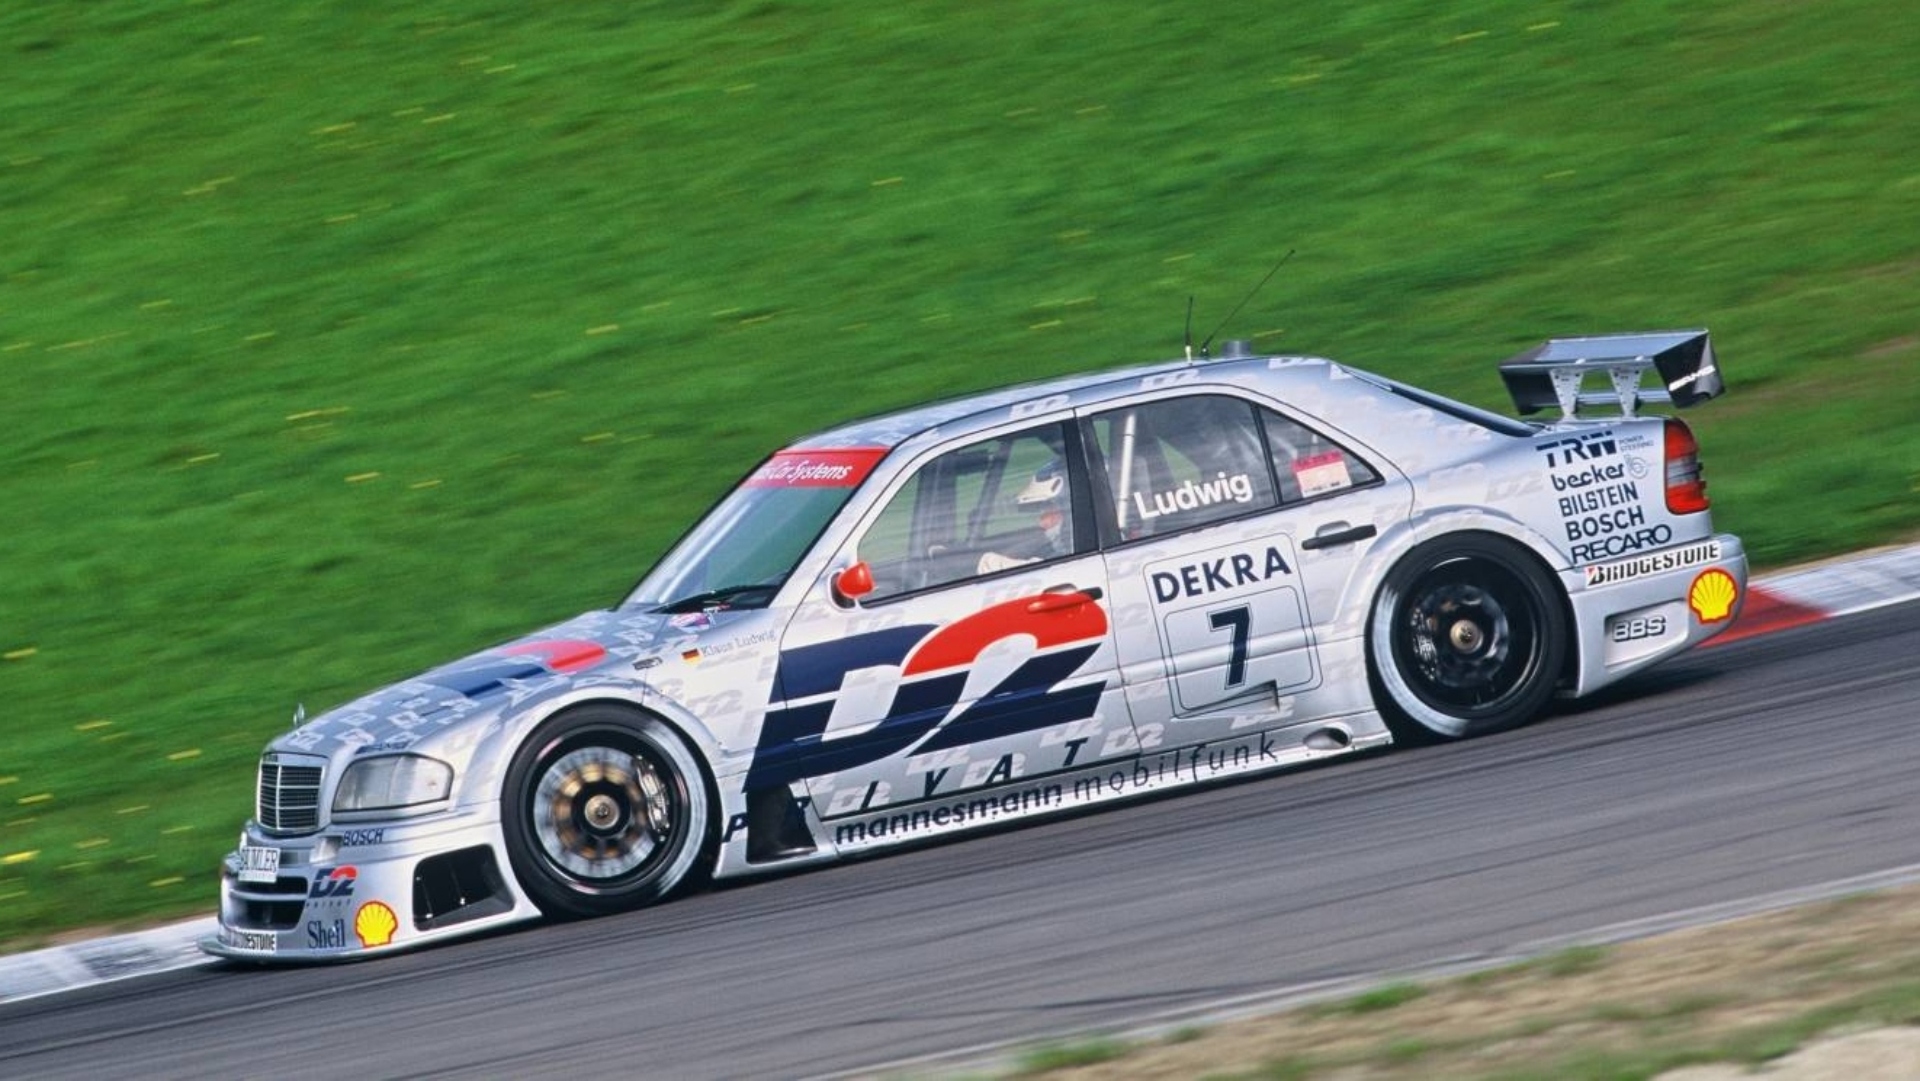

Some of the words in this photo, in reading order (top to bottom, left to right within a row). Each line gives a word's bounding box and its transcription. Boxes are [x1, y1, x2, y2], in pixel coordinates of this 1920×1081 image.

[1536, 430, 1617, 468] TRW
[787, 459, 854, 484] Systems
[1551, 463, 1625, 492] becker
[1133, 471, 1254, 520] Ludwig
[1558, 481, 1640, 518] BILSTEIN
[1565, 505, 1645, 542] BOSCH
[1570, 524, 1673, 564] RECARO
[1151, 546, 1293, 604] DEKRA
[1588, 543, 1719, 586] BRIDGESTONE
[1207, 602, 1251, 690] 7
[1613, 615, 1667, 643] BBS
[741, 592, 1109, 794] D2
[836, 782, 1062, 846] mannesmann
[1074, 731, 1278, 803] mobilfunk
[343, 828, 385, 847] BOSCH
[308, 866, 358, 898] D2
[307, 918, 346, 949] Shell
